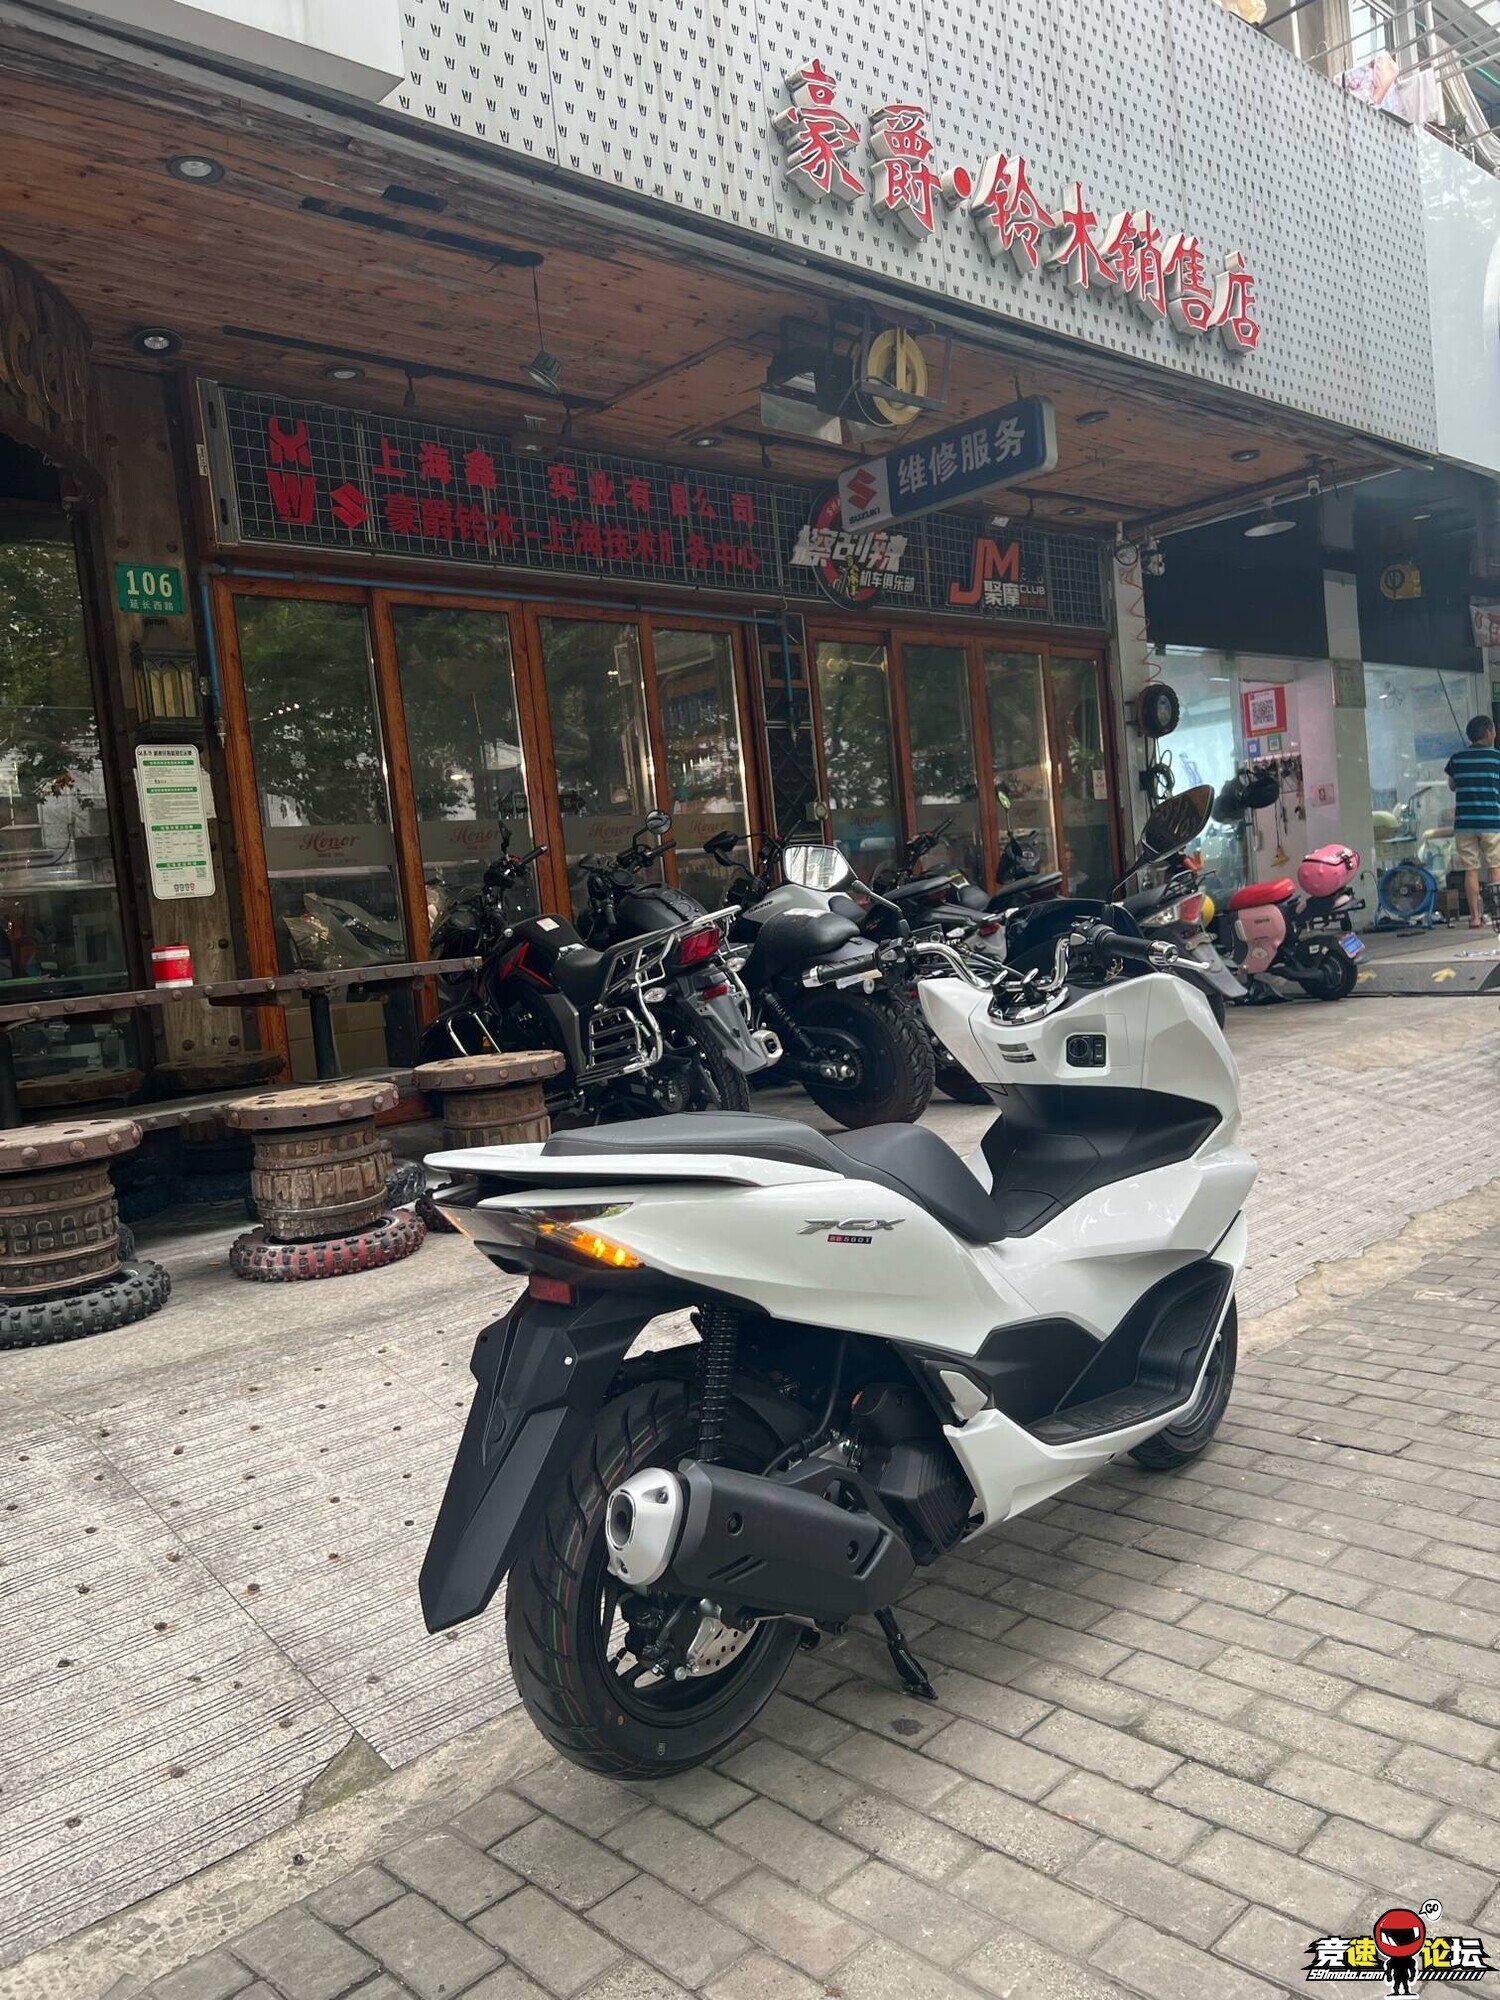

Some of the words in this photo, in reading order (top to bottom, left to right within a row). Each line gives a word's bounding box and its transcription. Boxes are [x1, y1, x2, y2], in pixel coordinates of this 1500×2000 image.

[897, 415, 1026, 496] 维修服务
[848, 507, 881, 525] SUZUKI
[126, 569, 173, 598] 106
[859, 569, 916, 593] 机车俱乐部
[949, 538, 1021, 605] JM
[983, 580, 1020, 607] 聚摩
[1019, 584, 1046, 596] CLUB
